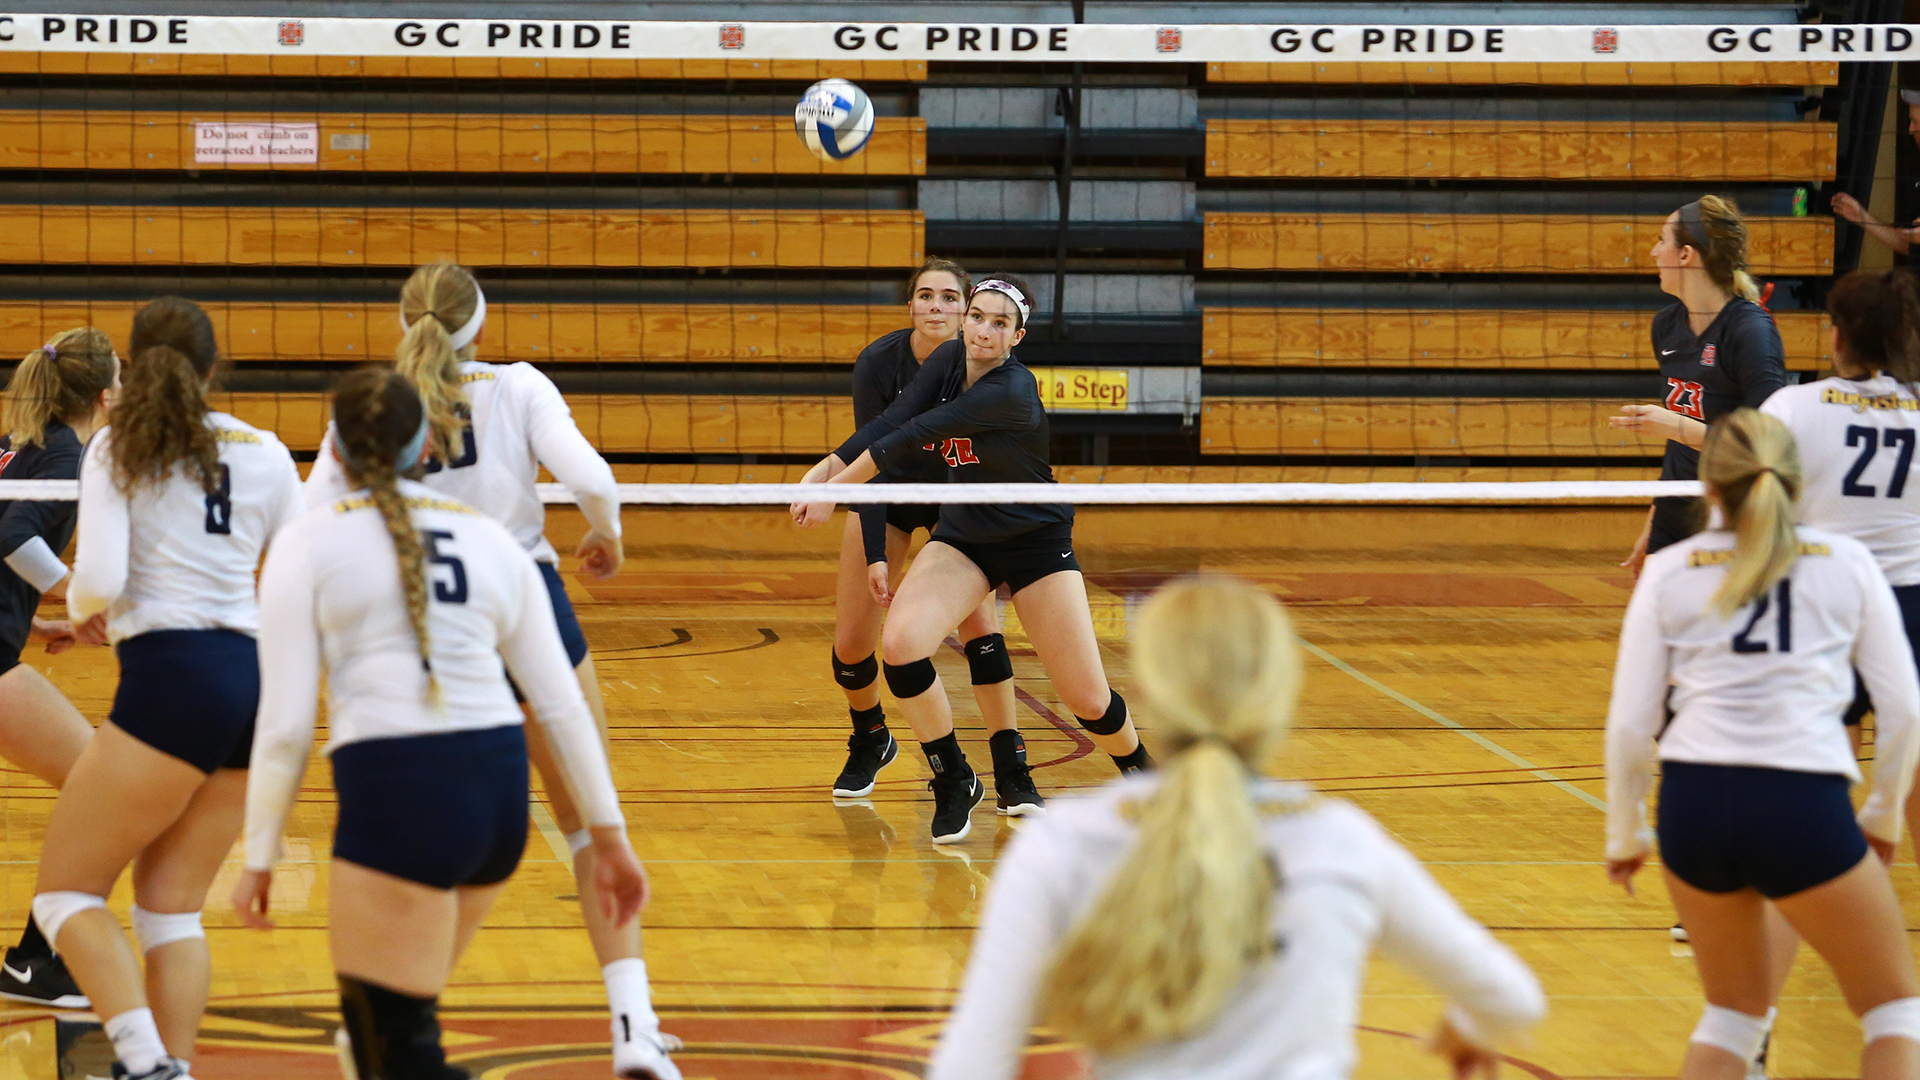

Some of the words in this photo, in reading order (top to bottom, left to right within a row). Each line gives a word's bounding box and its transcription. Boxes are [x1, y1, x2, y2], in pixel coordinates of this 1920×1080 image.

[43, 18, 187, 43] PRIDE
[395, 23, 460, 47] GC
[488, 24, 630, 48] PRIDE
[835, 27, 898, 50] GC
[927, 28, 1068, 51] PRIDE
[1271, 29, 1334, 53] GC
[1362, 29, 1503, 52] PRIDE
[1707, 28, 1772, 52] GC
[1800, 28, 1912, 52] PRID
[203, 129, 223, 139] Do
[227, 131, 248, 139] not
[257, 129, 290, 139] climb
[196, 145, 254, 154] retracted
[260, 145, 314, 154] bleachers
[1056, 381, 1065, 398] a
[1073, 374, 1126, 406] Step
[1666, 377, 1706, 420] 23
[1842, 424, 1916, 498] 27
[1732, 577, 1791, 653] 21
